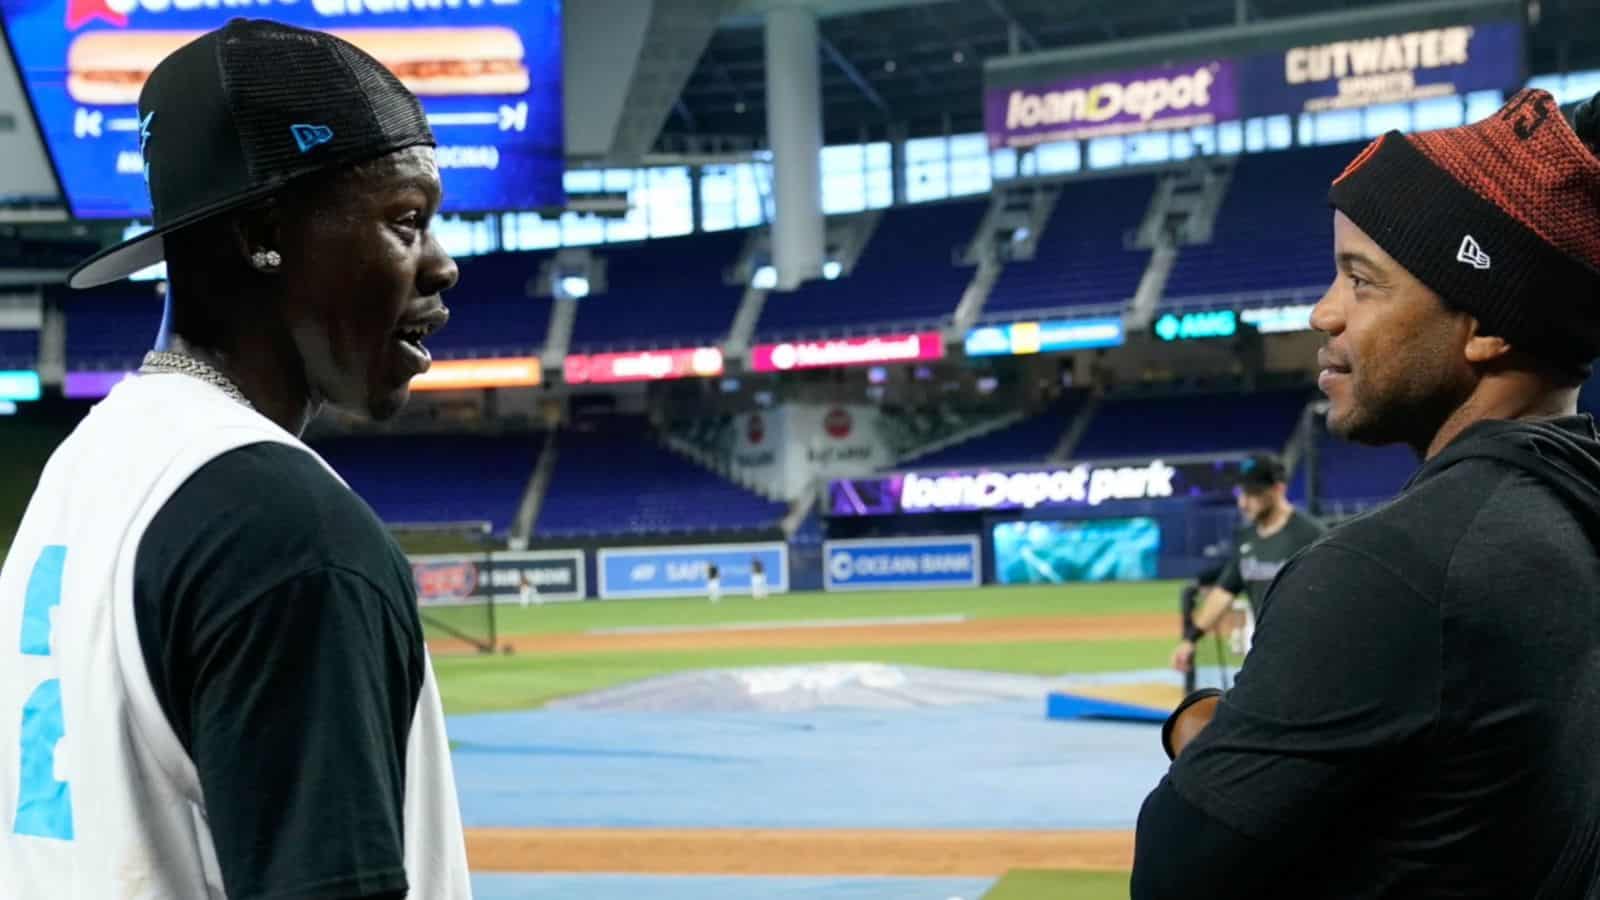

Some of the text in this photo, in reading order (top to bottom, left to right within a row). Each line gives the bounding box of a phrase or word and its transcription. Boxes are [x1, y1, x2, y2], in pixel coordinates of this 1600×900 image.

[1285, 26, 1468, 84] CUTWATER
[1006, 67, 1214, 130] loanDepot
[902, 459, 1175, 509] loanDepot park
